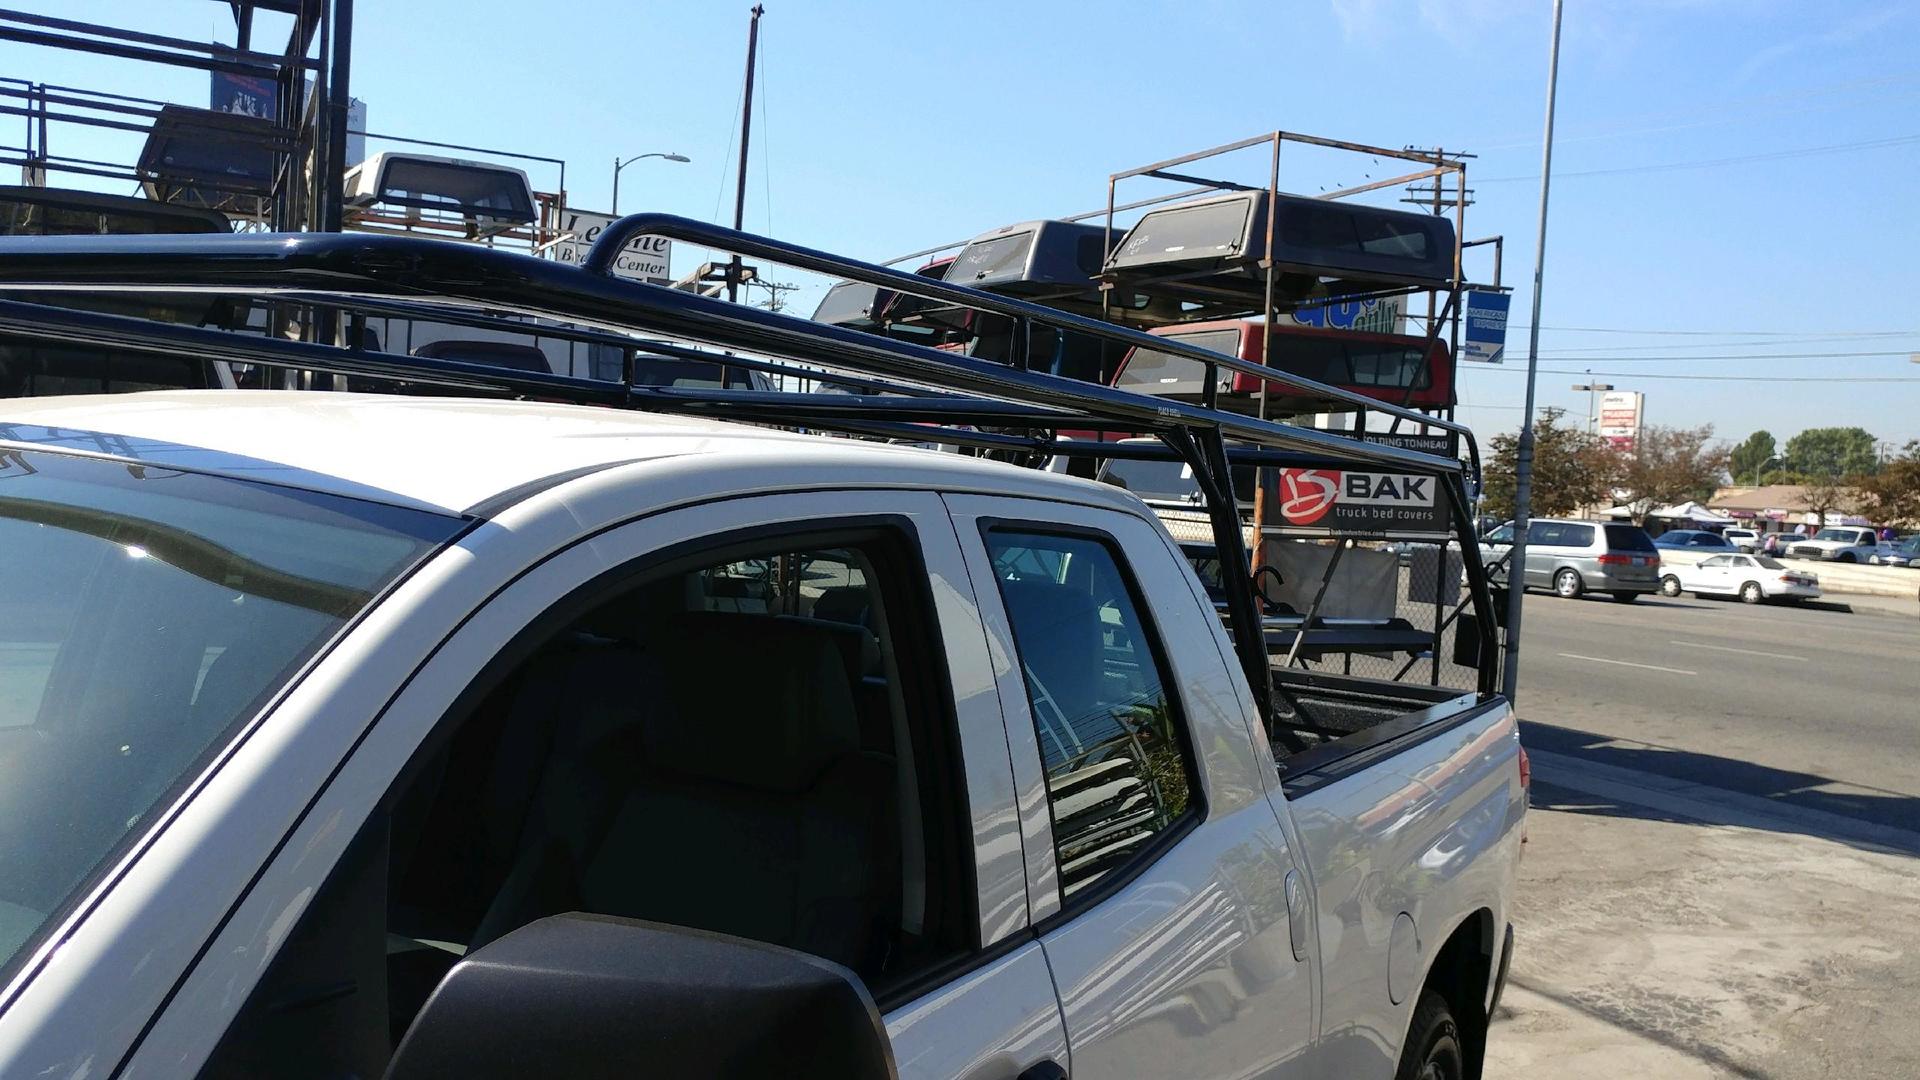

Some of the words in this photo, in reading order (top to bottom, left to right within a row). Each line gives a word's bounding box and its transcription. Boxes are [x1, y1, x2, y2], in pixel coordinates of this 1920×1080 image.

[616, 255, 665, 275] Center
[1467, 308, 1506, 319] AMERICAN
[1404, 439, 1448, 450] TONNEAU
[1346, 474, 1427, 501] BAK
[1336, 507, 1367, 518] truck
[1372, 507, 1394, 519] bed
[1397, 510, 1434, 520] covers
